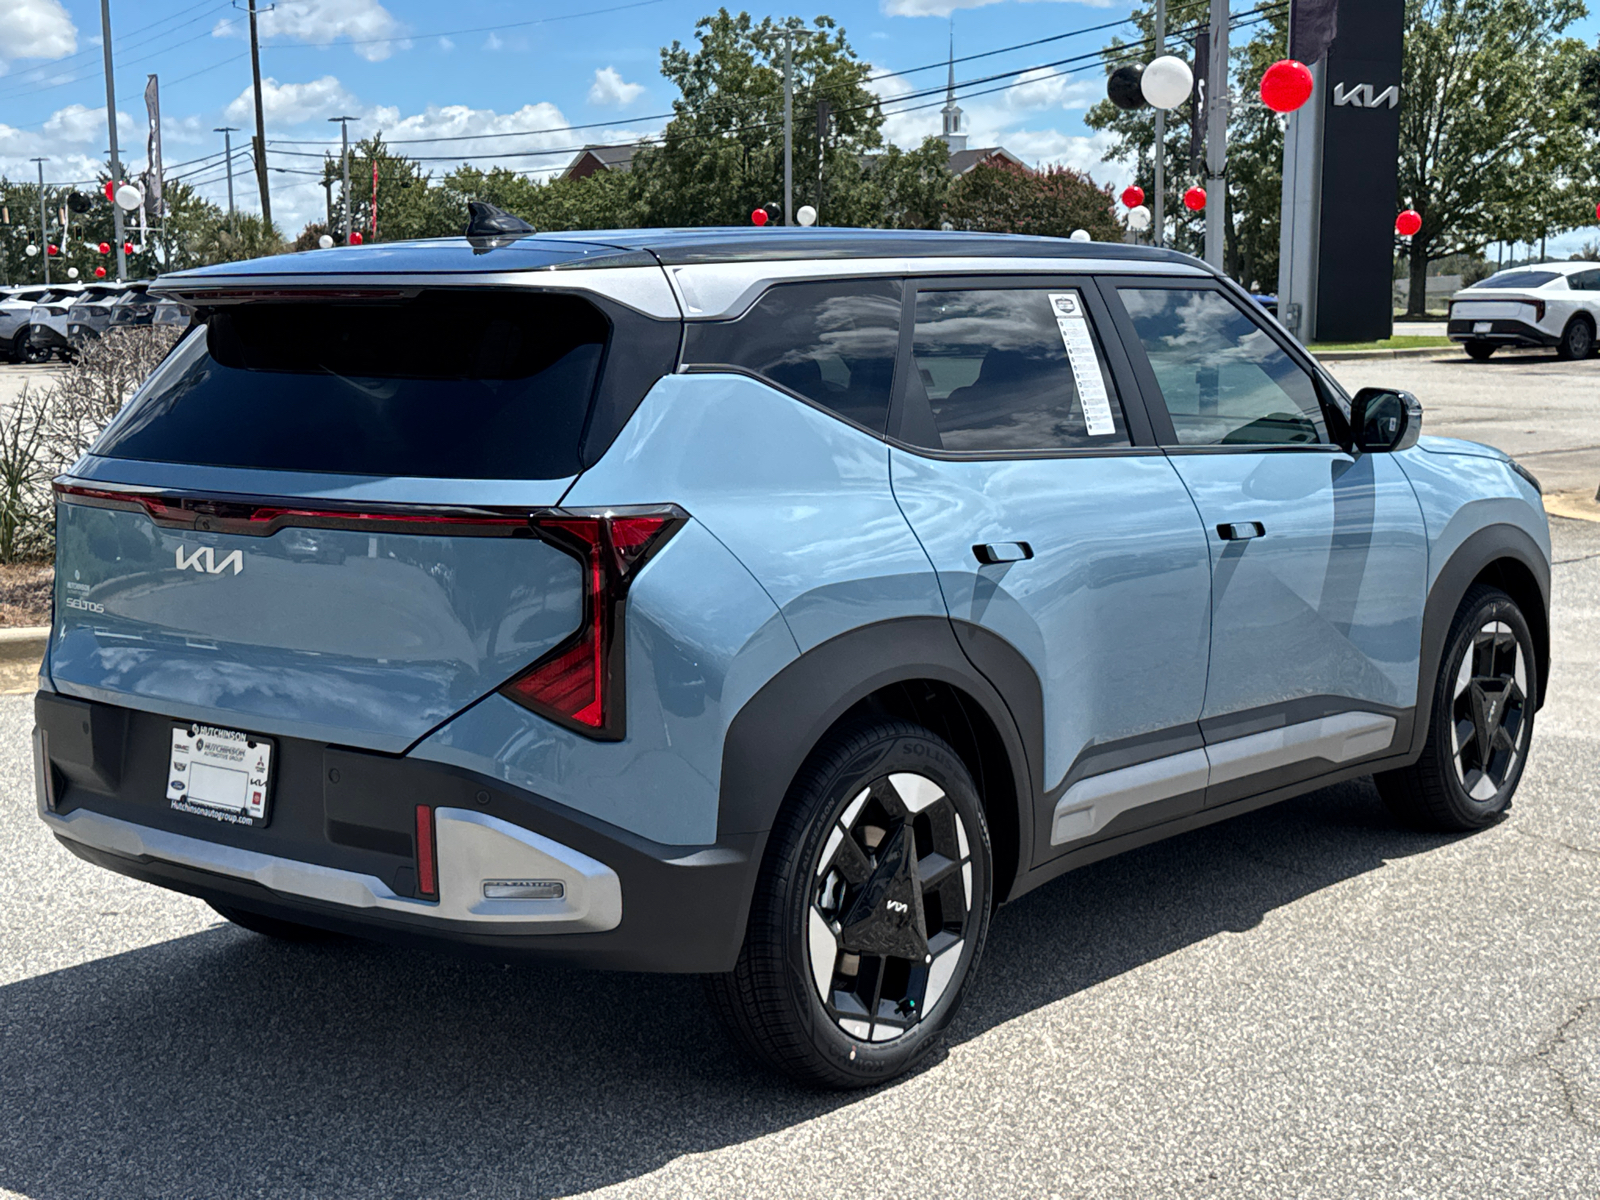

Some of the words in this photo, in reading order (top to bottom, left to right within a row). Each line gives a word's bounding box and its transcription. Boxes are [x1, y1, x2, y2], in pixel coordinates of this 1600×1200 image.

[1333, 82, 1399, 109] KIA
[175, 544, 244, 576] KIA
[65, 597, 105, 614] SELTOS
[200, 726, 246, 741] HUTCHINSON
[203, 742, 246, 756] HUTCHINSON
[902, 742, 953, 772] SOLUS
[802, 796, 837, 871] ALL-SEASON
